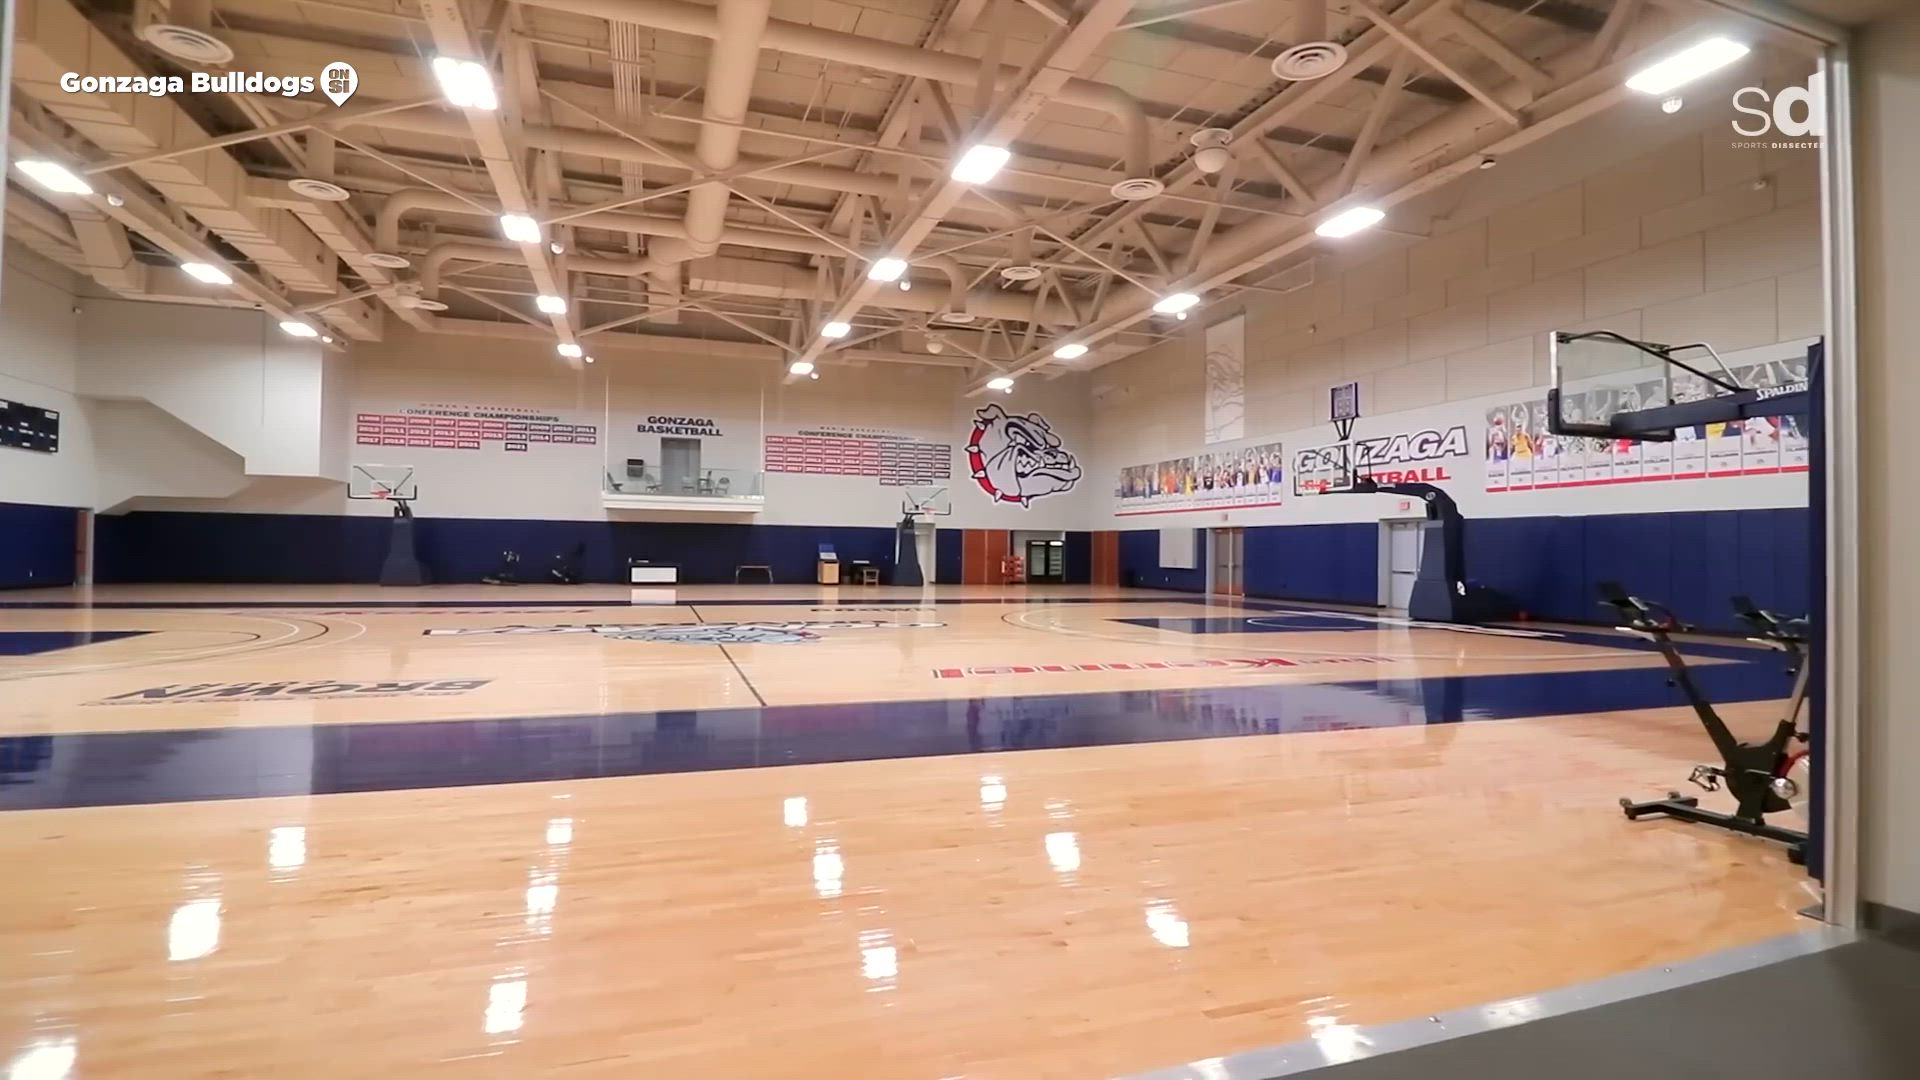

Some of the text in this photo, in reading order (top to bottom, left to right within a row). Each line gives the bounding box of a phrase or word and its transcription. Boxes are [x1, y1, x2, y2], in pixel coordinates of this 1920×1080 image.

[1756, 381, 1809, 401] SPALDIN
[399, 408, 560, 422] CONFERENCE CHAMPIONSHIPS
[647, 416, 714, 427] GONZAGA
[637, 424, 723, 436] BASKETBALL
[1293, 426, 1468, 475] GONZAGA
[104, 680, 491, 700] BROWN
